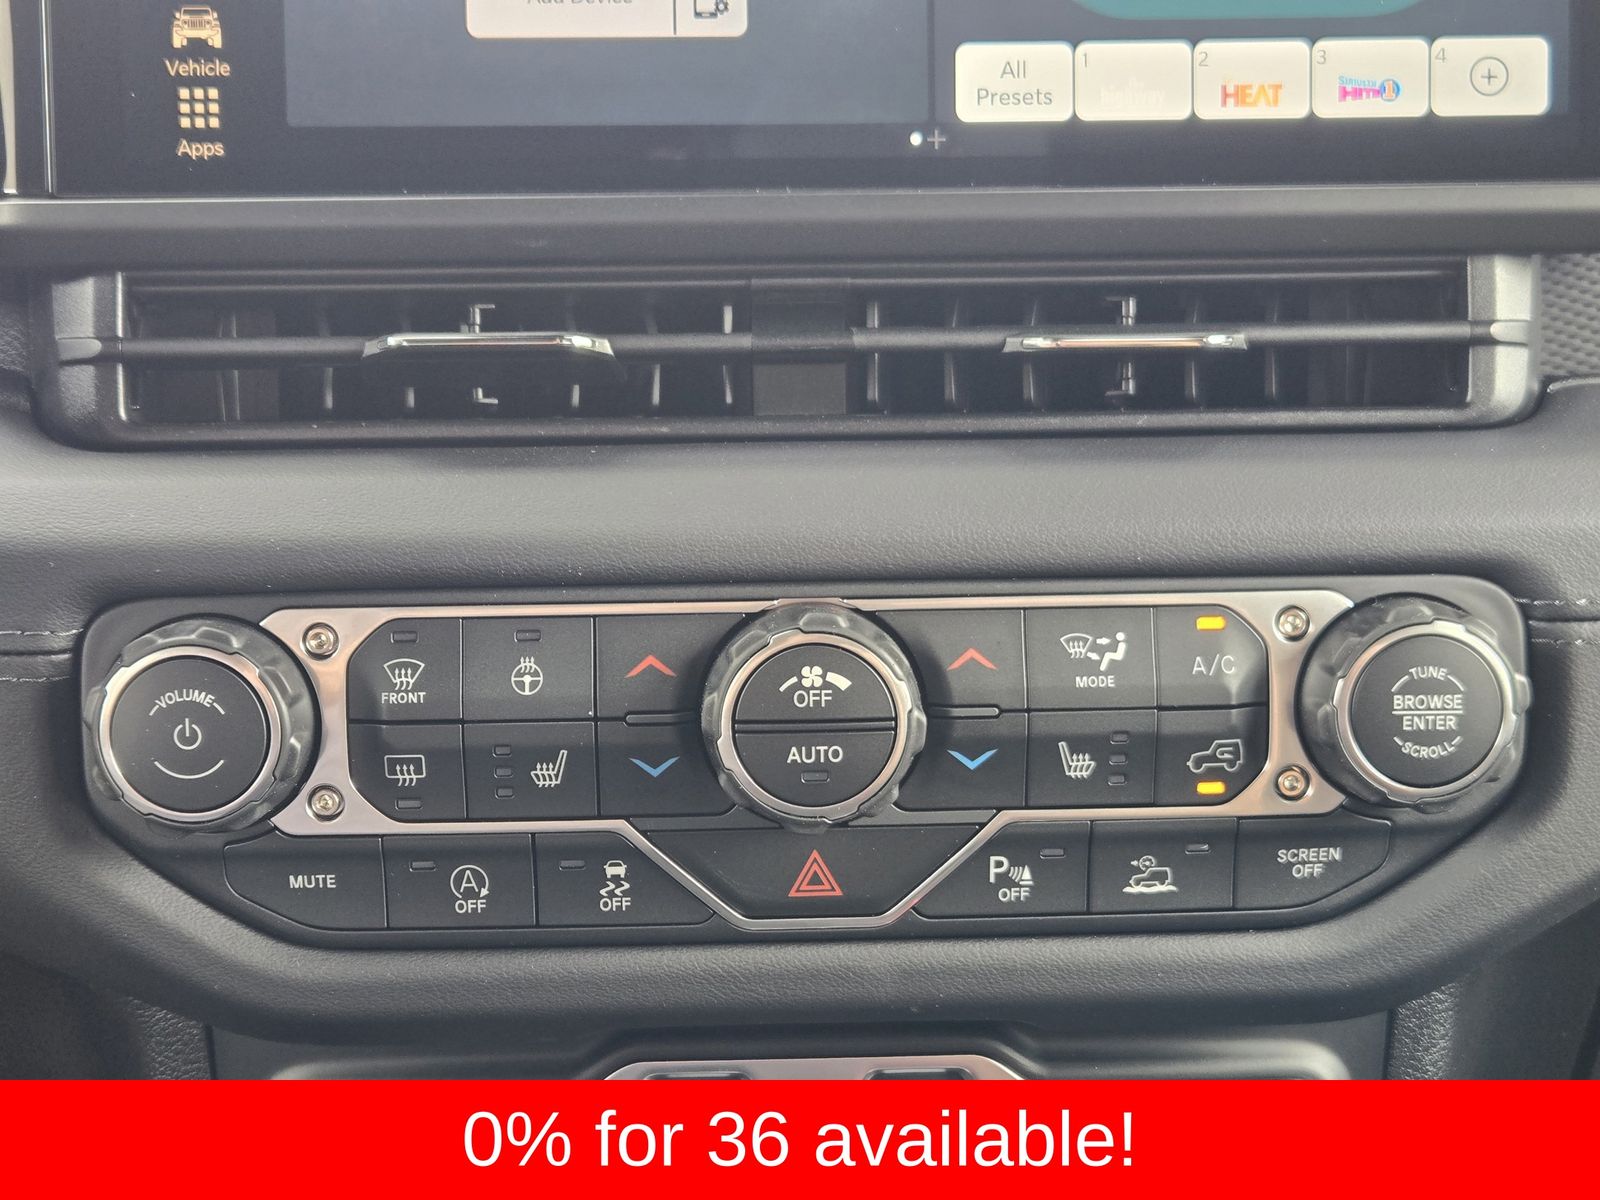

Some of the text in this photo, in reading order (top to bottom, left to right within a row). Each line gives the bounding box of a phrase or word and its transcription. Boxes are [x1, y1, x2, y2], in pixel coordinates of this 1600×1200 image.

[1198, 51, 1209, 67] 2
[1316, 49, 1327, 65] 3
[1435, 47, 1447, 63] 4
[164, 58, 231, 77] Vehicle
[1000, 60, 1027, 79] All
[977, 88, 1053, 106] Presets
[1220, 84, 1283, 108] HEAT
[177, 139, 225, 160] Apps
[1192, 654, 1237, 677] A/C
[1410, 666, 1448, 681] TUNE
[1075, 675, 1117, 689] MODE
[155, 690, 215, 709] VOLUME
[381, 692, 427, 705] FRONT
[793, 690, 833, 708] OFF
[1393, 694, 1463, 712] BROWSE
[1402, 715, 1457, 732] ENTER
[787, 745, 844, 764] AUTO
[1401, 738, 1456, 761] SCROLL
[1277, 847, 1341, 866] SCREEN
[1292, 862, 1323, 879] OFF
[289, 873, 337, 890] MUTE
[998, 887, 1030, 903] OFF
[455, 898, 487, 915] OFF
[599, 897, 631, 914] OFF
